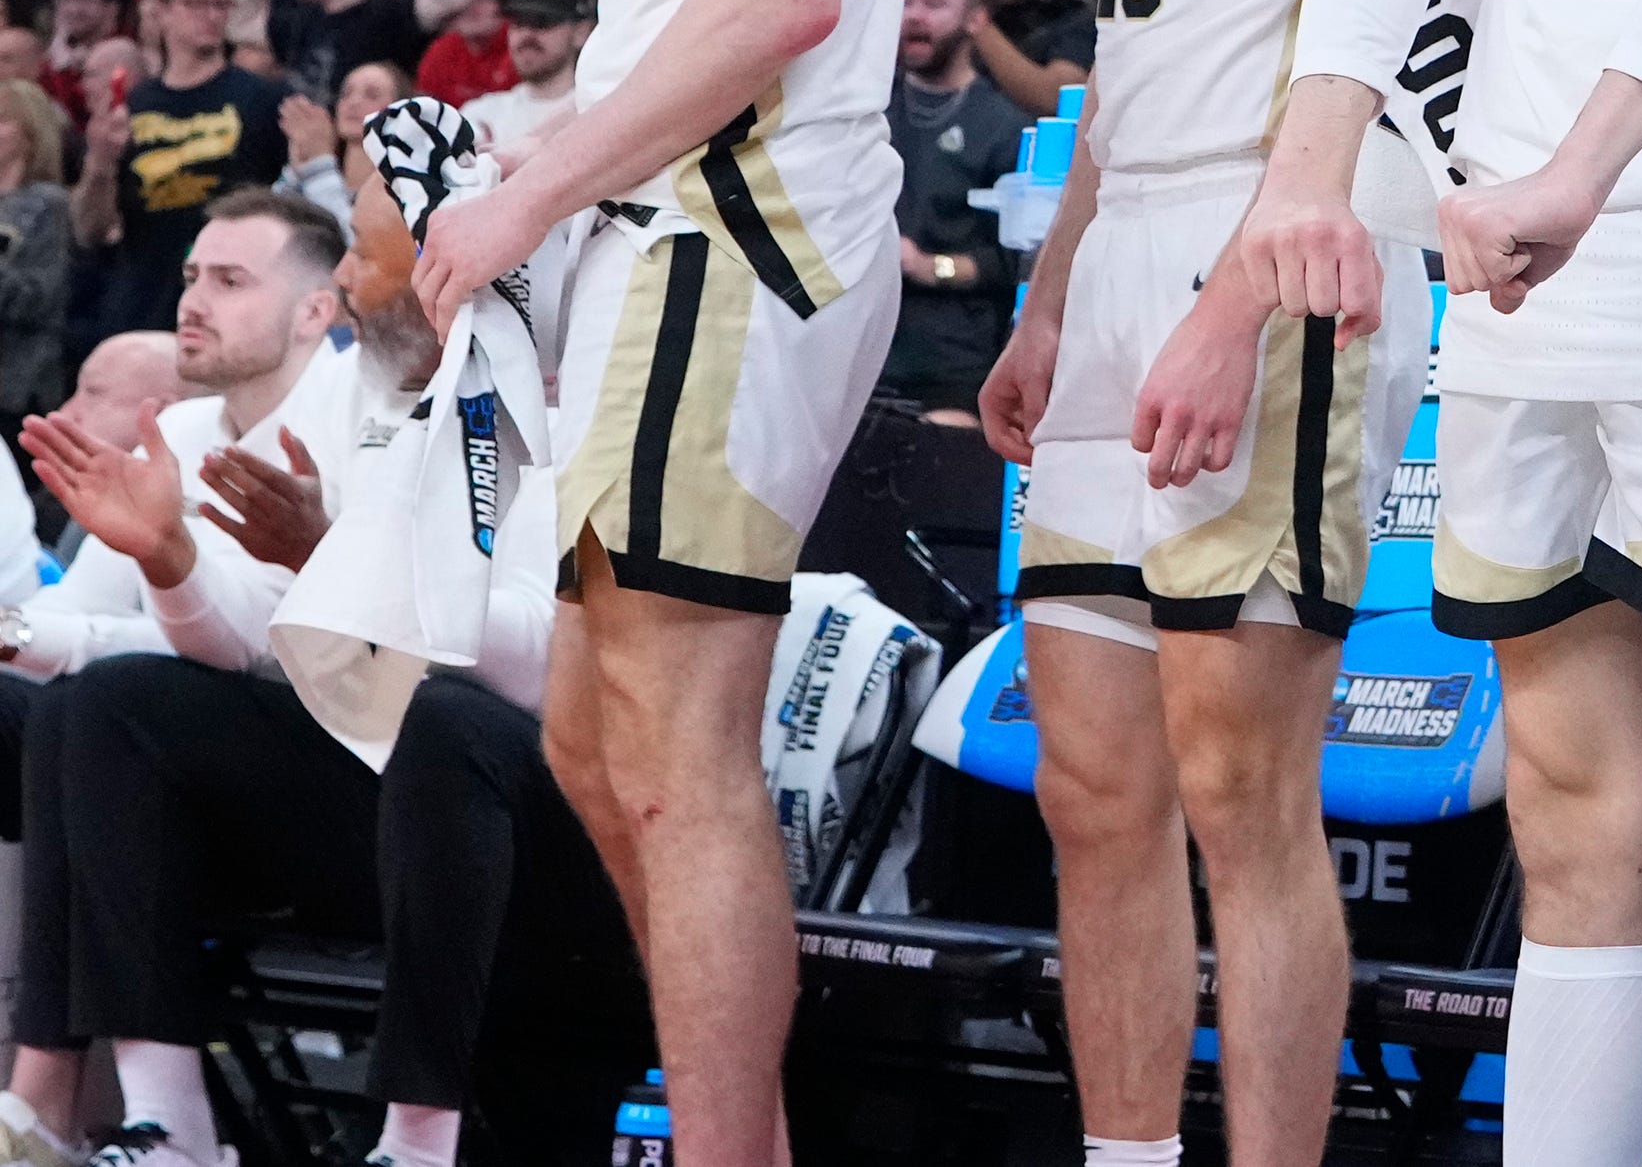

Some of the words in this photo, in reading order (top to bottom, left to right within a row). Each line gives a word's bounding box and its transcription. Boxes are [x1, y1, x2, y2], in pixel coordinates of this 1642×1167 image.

[1346, 678, 1433, 708] MARCH
[1347, 706, 1459, 738] MADNESS
[822, 935, 850, 958] THE
[850, 939, 891, 964] FINAL
[893, 944, 934, 969] FOUR
[1405, 989, 1436, 1011] THE
[1436, 992, 1484, 1016] ROAD
[1485, 996, 1508, 1019] TO
